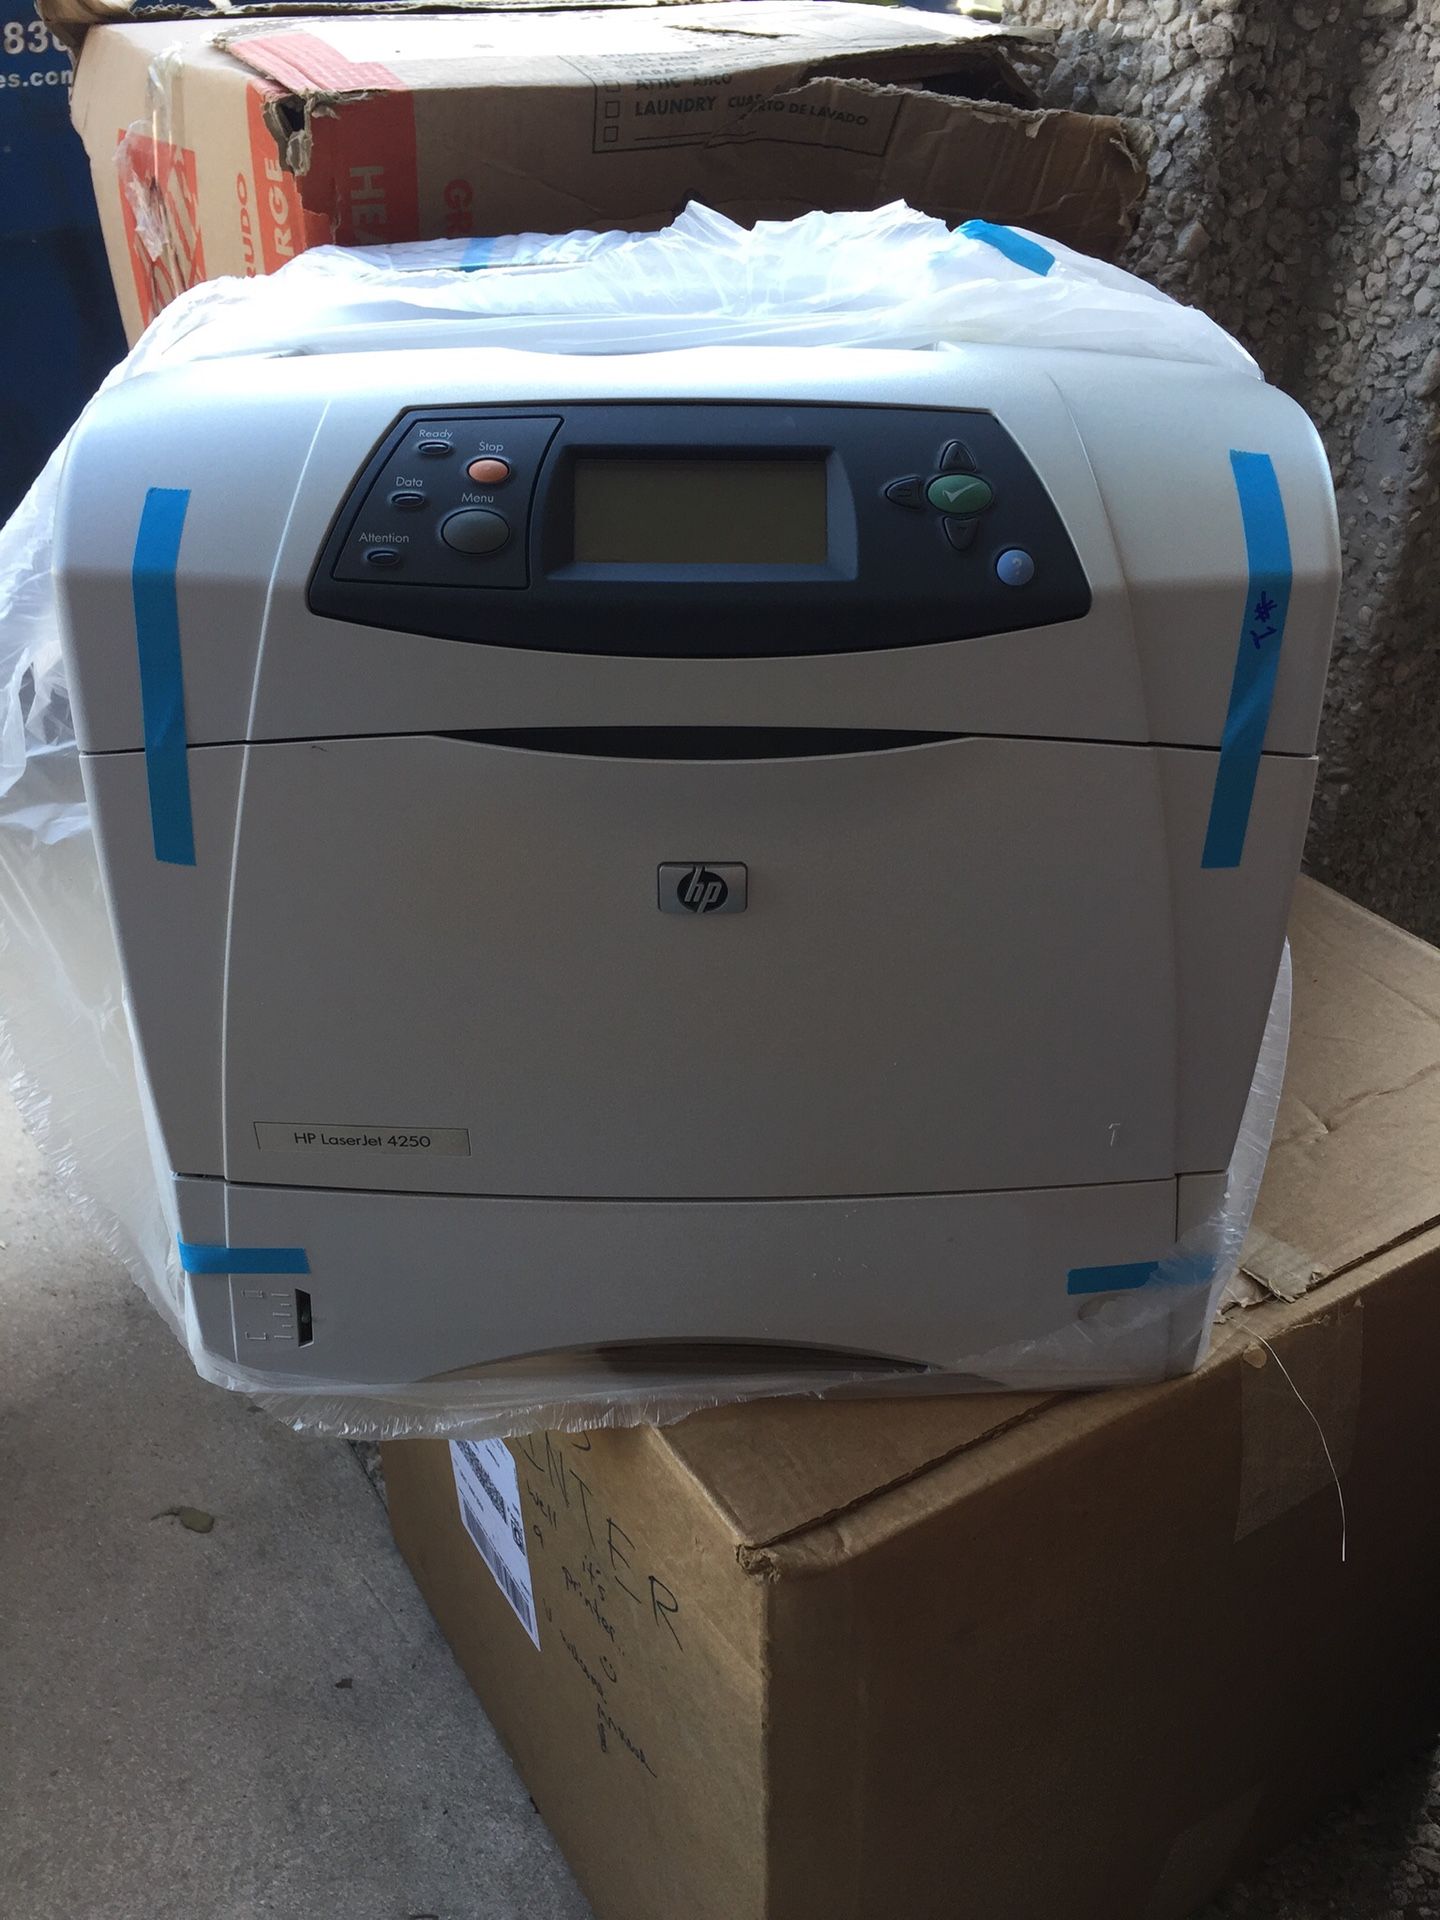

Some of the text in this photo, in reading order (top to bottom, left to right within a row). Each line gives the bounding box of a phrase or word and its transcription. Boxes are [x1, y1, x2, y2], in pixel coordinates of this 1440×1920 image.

[634, 96, 717, 118] LAUNDRY
[788, 102, 808, 115] DE
[810, 105, 869, 126] LAVADO
[418, 429, 453, 439] Ready
[479, 441, 504, 453] Stop
[395, 476, 423, 488] Data
[461, 493, 495, 504] Menu
[358, 532, 410, 544] Attention
[294, 1132, 431, 1148] HP LaserJet 4250
